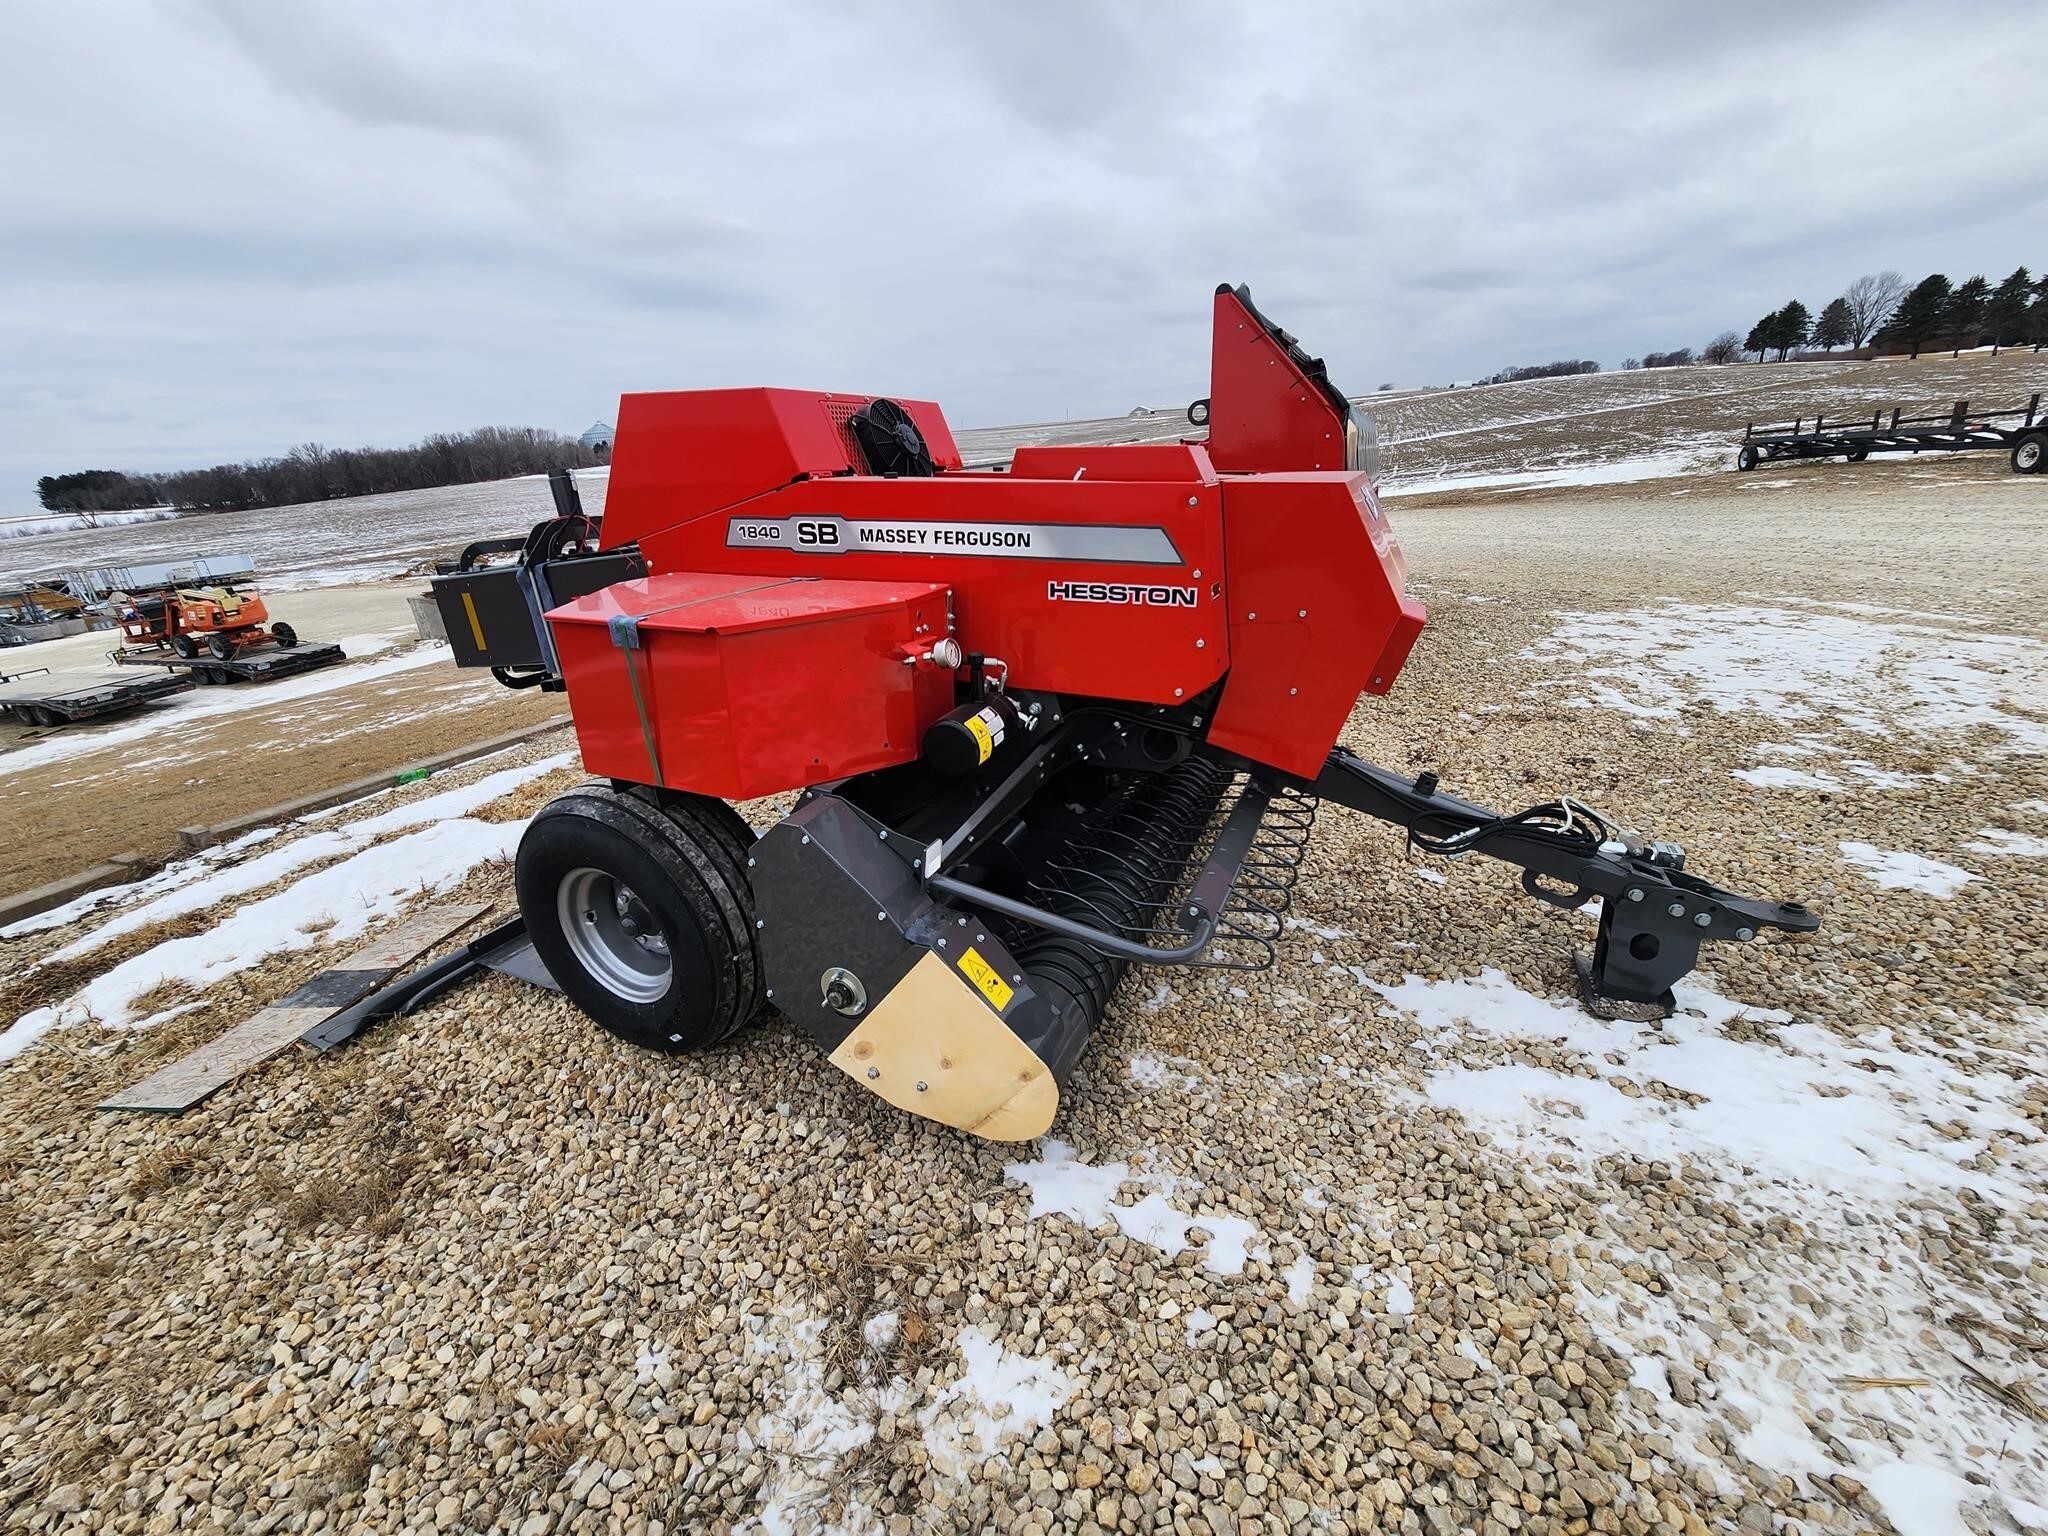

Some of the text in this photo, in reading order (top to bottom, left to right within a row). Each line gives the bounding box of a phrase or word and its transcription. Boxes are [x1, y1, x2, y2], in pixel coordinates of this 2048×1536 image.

[738, 521, 1031, 548] 1840 SB MASSEY FERGUSON
[1048, 582, 1198, 608] HESSTON
